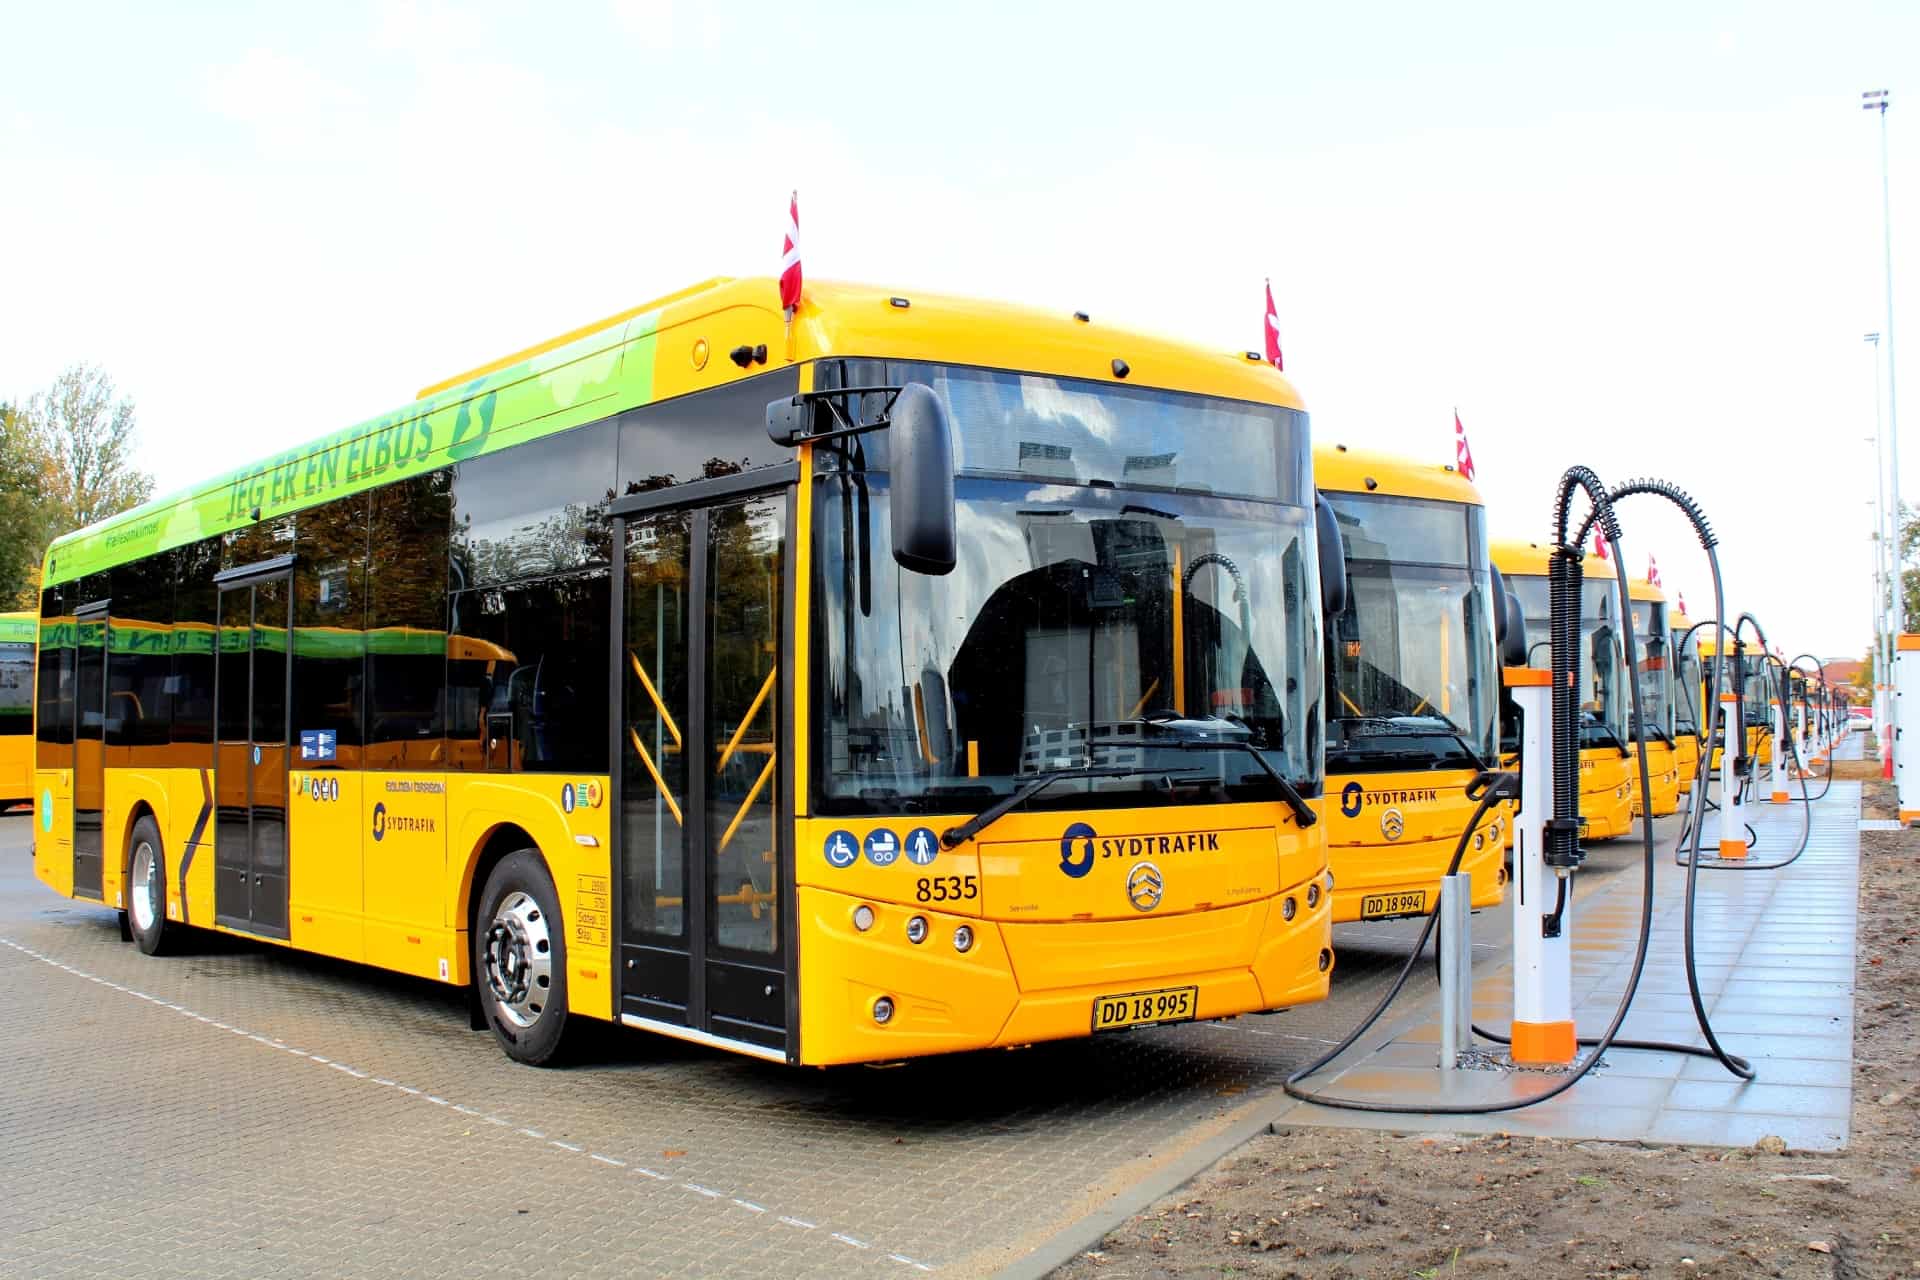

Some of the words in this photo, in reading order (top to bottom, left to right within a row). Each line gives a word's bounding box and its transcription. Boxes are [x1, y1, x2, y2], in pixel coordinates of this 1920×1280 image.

[225, 464, 265, 523] JEG
[270, 452, 298, 509] ER
[303, 437, 344, 497] EN
[345, 400, 434, 484] ELBUS
[1365, 791, 1436, 806] SYDTRAFIK
[387, 816, 435, 832] SYDTRAFIK
[1102, 832, 1219, 859] SYDTRAFIK
[916, 875, 978, 902] 8535
[1368, 899, 1383, 913] DD
[1386, 897, 1398, 912] 18
[1400, 895, 1420, 910] 994
[1102, 1002, 1127, 1023] DD
[1133, 998, 1153, 1020] 18
[1157, 993, 1188, 1017] 995
